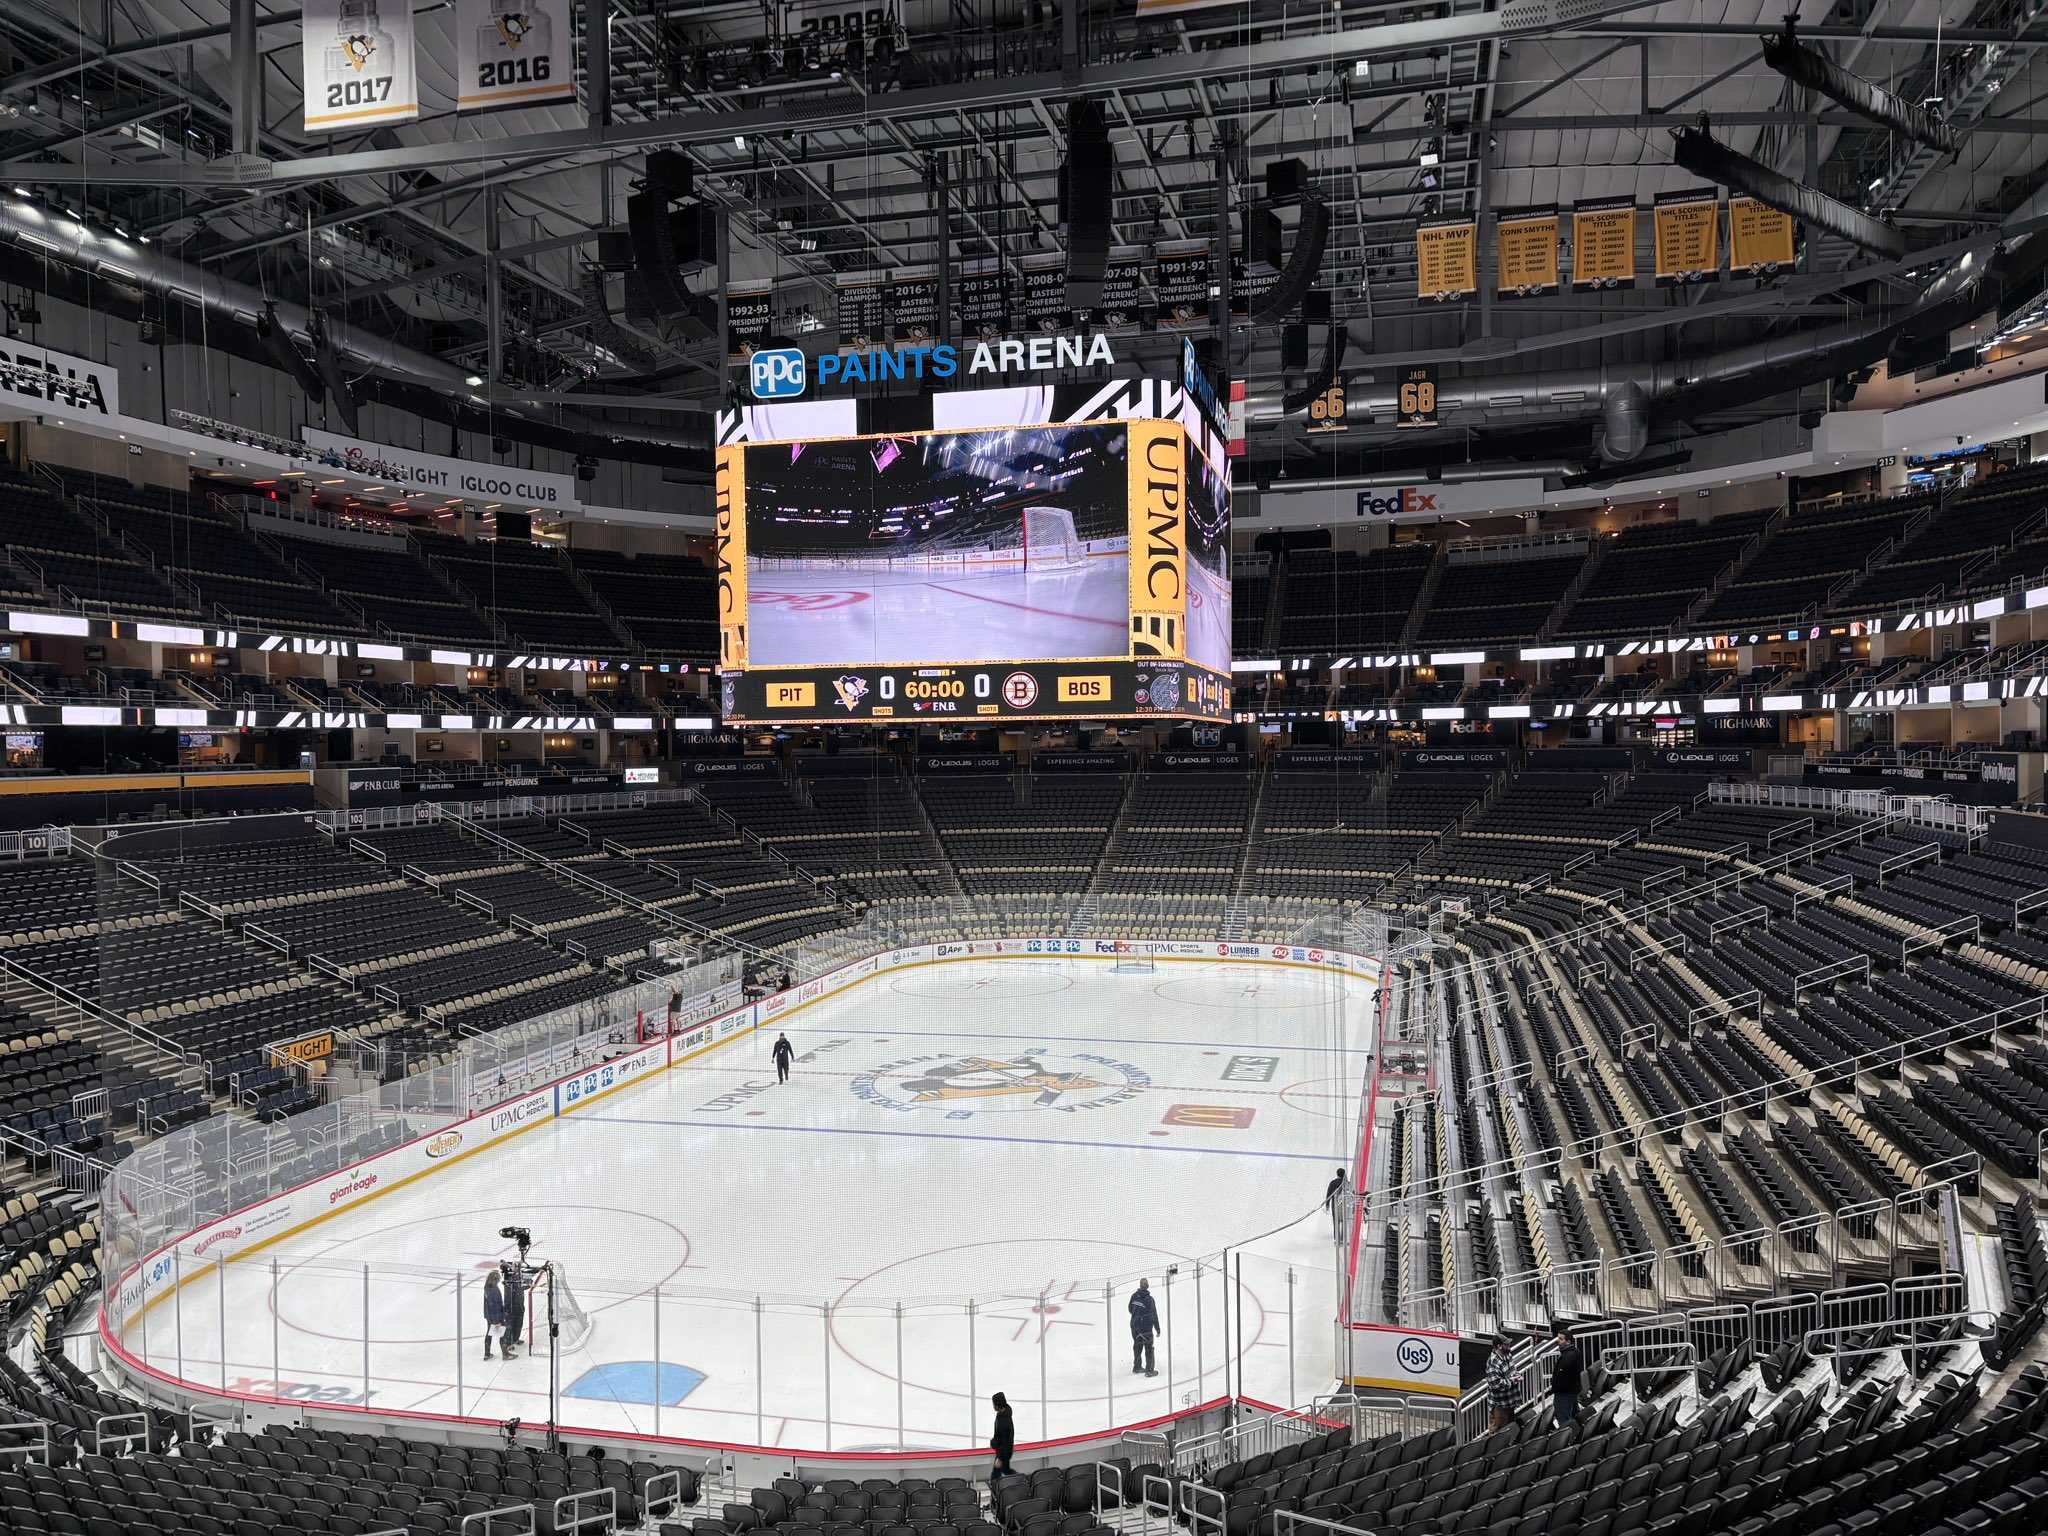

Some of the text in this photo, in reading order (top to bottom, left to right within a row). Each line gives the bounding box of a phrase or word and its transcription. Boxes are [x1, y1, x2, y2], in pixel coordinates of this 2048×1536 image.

[478, 56, 551, 88] 2016
[327, 76, 393, 107] 2017
[1678, 205, 1711, 214] SCORING
[1597, 213, 1629, 221] SCORING
[1423, 229, 1469, 242] NHL MVP
[1500, 225, 1555, 237] CONN SMYTHE
[1103, 267, 1138, 279] 07-08
[1160, 261, 1206, 273] 1991-92
[1027, 273, 1064, 286] 2008-0
[1169, 276, 1196, 285] WALES
[844, 287, 877, 296] DIVISION
[1160, 292, 1206, 303] CHAMPIONS
[840, 293, 881, 303] CHAMPIONS
[901, 297, 934, 306] EASTERN
[730, 304, 769, 316] 1992-93
[735, 326, 763, 335] TROPHY
[753, 334, 1114, 393] PPG PAINTS ARENA
[1408, 370, 1426, 380] JAGR
[1311, 388, 1344, 420] 66
[1400, 382, 1435, 414] 68
[129, 445, 142, 454] 204
[1879, 456, 1895, 467] 215
[460, 475, 557, 501] IGLOO CLUB
[1357, 487, 1437, 516] FedEx
[1146, 436, 1181, 601] UPMC
[1523, 511, 1538, 519] 213
[779, 675, 965, 703] PIT 0 60:00
[974, 673, 990, 697] 0
[1068, 681, 1101, 696] BOS
[1449, 720, 1493, 734] FedEx
[1714, 716, 1772, 730] HIGHMARK
[683, 734, 739, 744] HIGHMARK
[1194, 728, 1219, 745] PPG
[1470, 753, 1494, 761] LOGES
[1680, 753, 1739, 761] LEXUS LOGES
[383, 780, 400, 789] CLUB
[505, 778, 539, 786] PENGUINS
[350, 813, 363, 824] 103
[417, 809, 429, 818] 103
[106, 830, 119, 838] 102
[28, 837, 47, 849] 101
[1028, 941, 1041, 951] PPG
[1048, 941, 1061, 951] PPG
[1067, 941, 1080, 951] PPG
[1146, 944, 1178, 954] UPMC
[1230, 946, 1260, 955] LUMBER
[294, 1038, 328, 1058] LIGHT
[568, 1068, 613, 1100] PPG PPG PPG
[692, 1080, 776, 1112] UPMC
[491, 1096, 545, 1132] UPMC SPORTS
[526, 1103, 549, 1117] MEDICINE
[329, 1174, 378, 1204] giant eagle
[1402, 1347, 1428, 1365] USS
